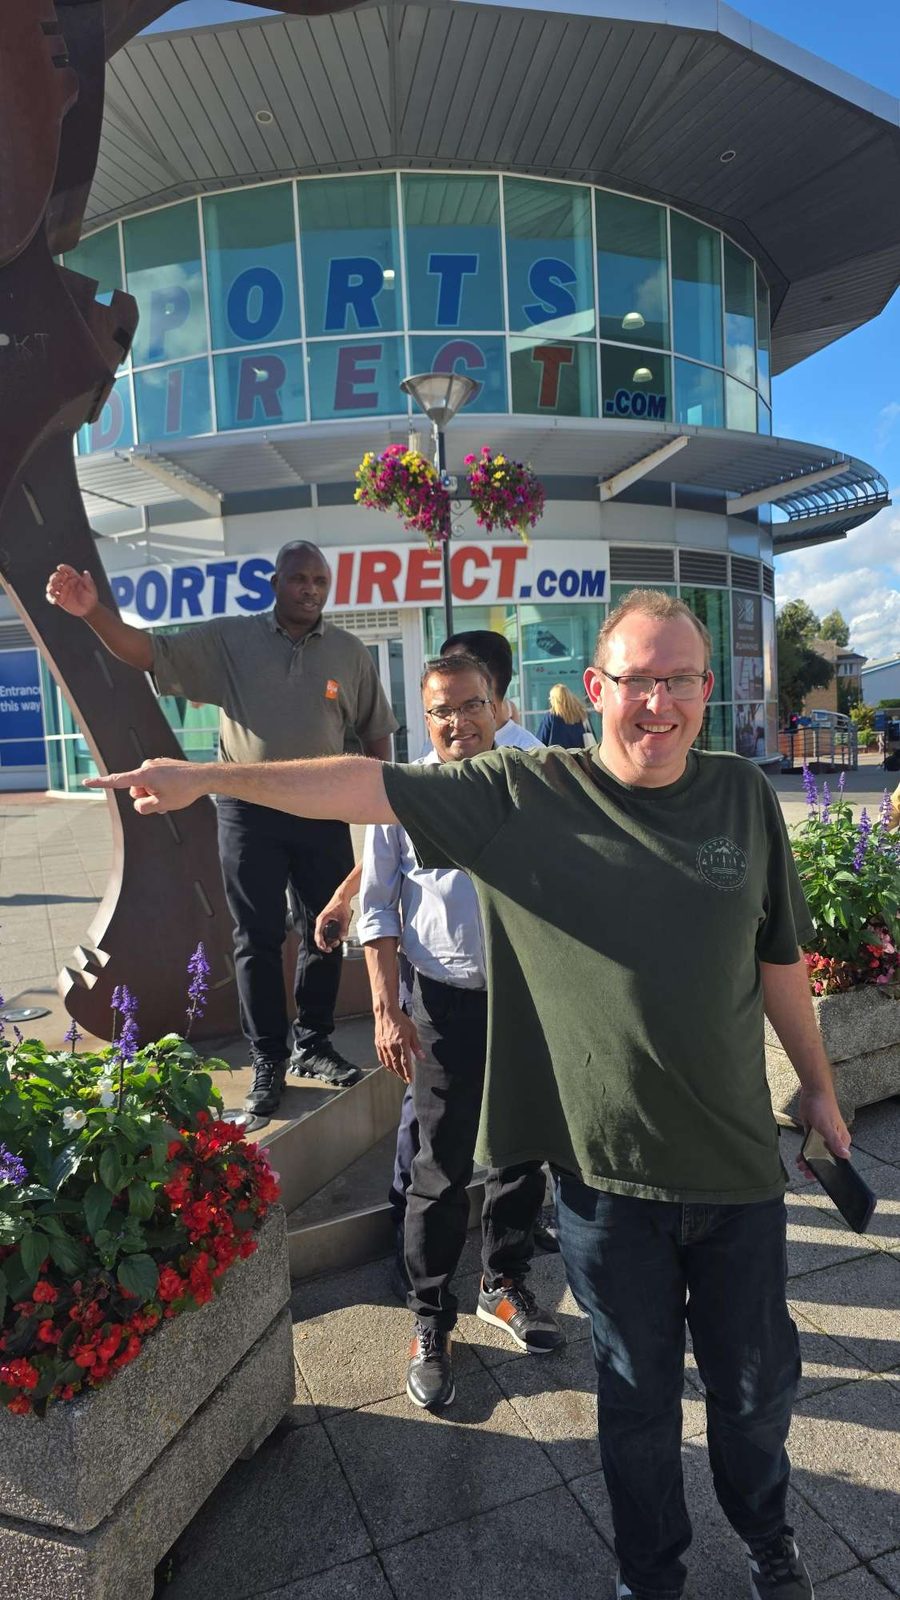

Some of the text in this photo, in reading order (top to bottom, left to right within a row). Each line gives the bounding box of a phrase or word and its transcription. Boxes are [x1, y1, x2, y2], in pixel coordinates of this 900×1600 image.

[148, 253, 578, 360] PORTS
[0, 686, 40, 697] Entranc
[0, 700, 41, 713] this way
